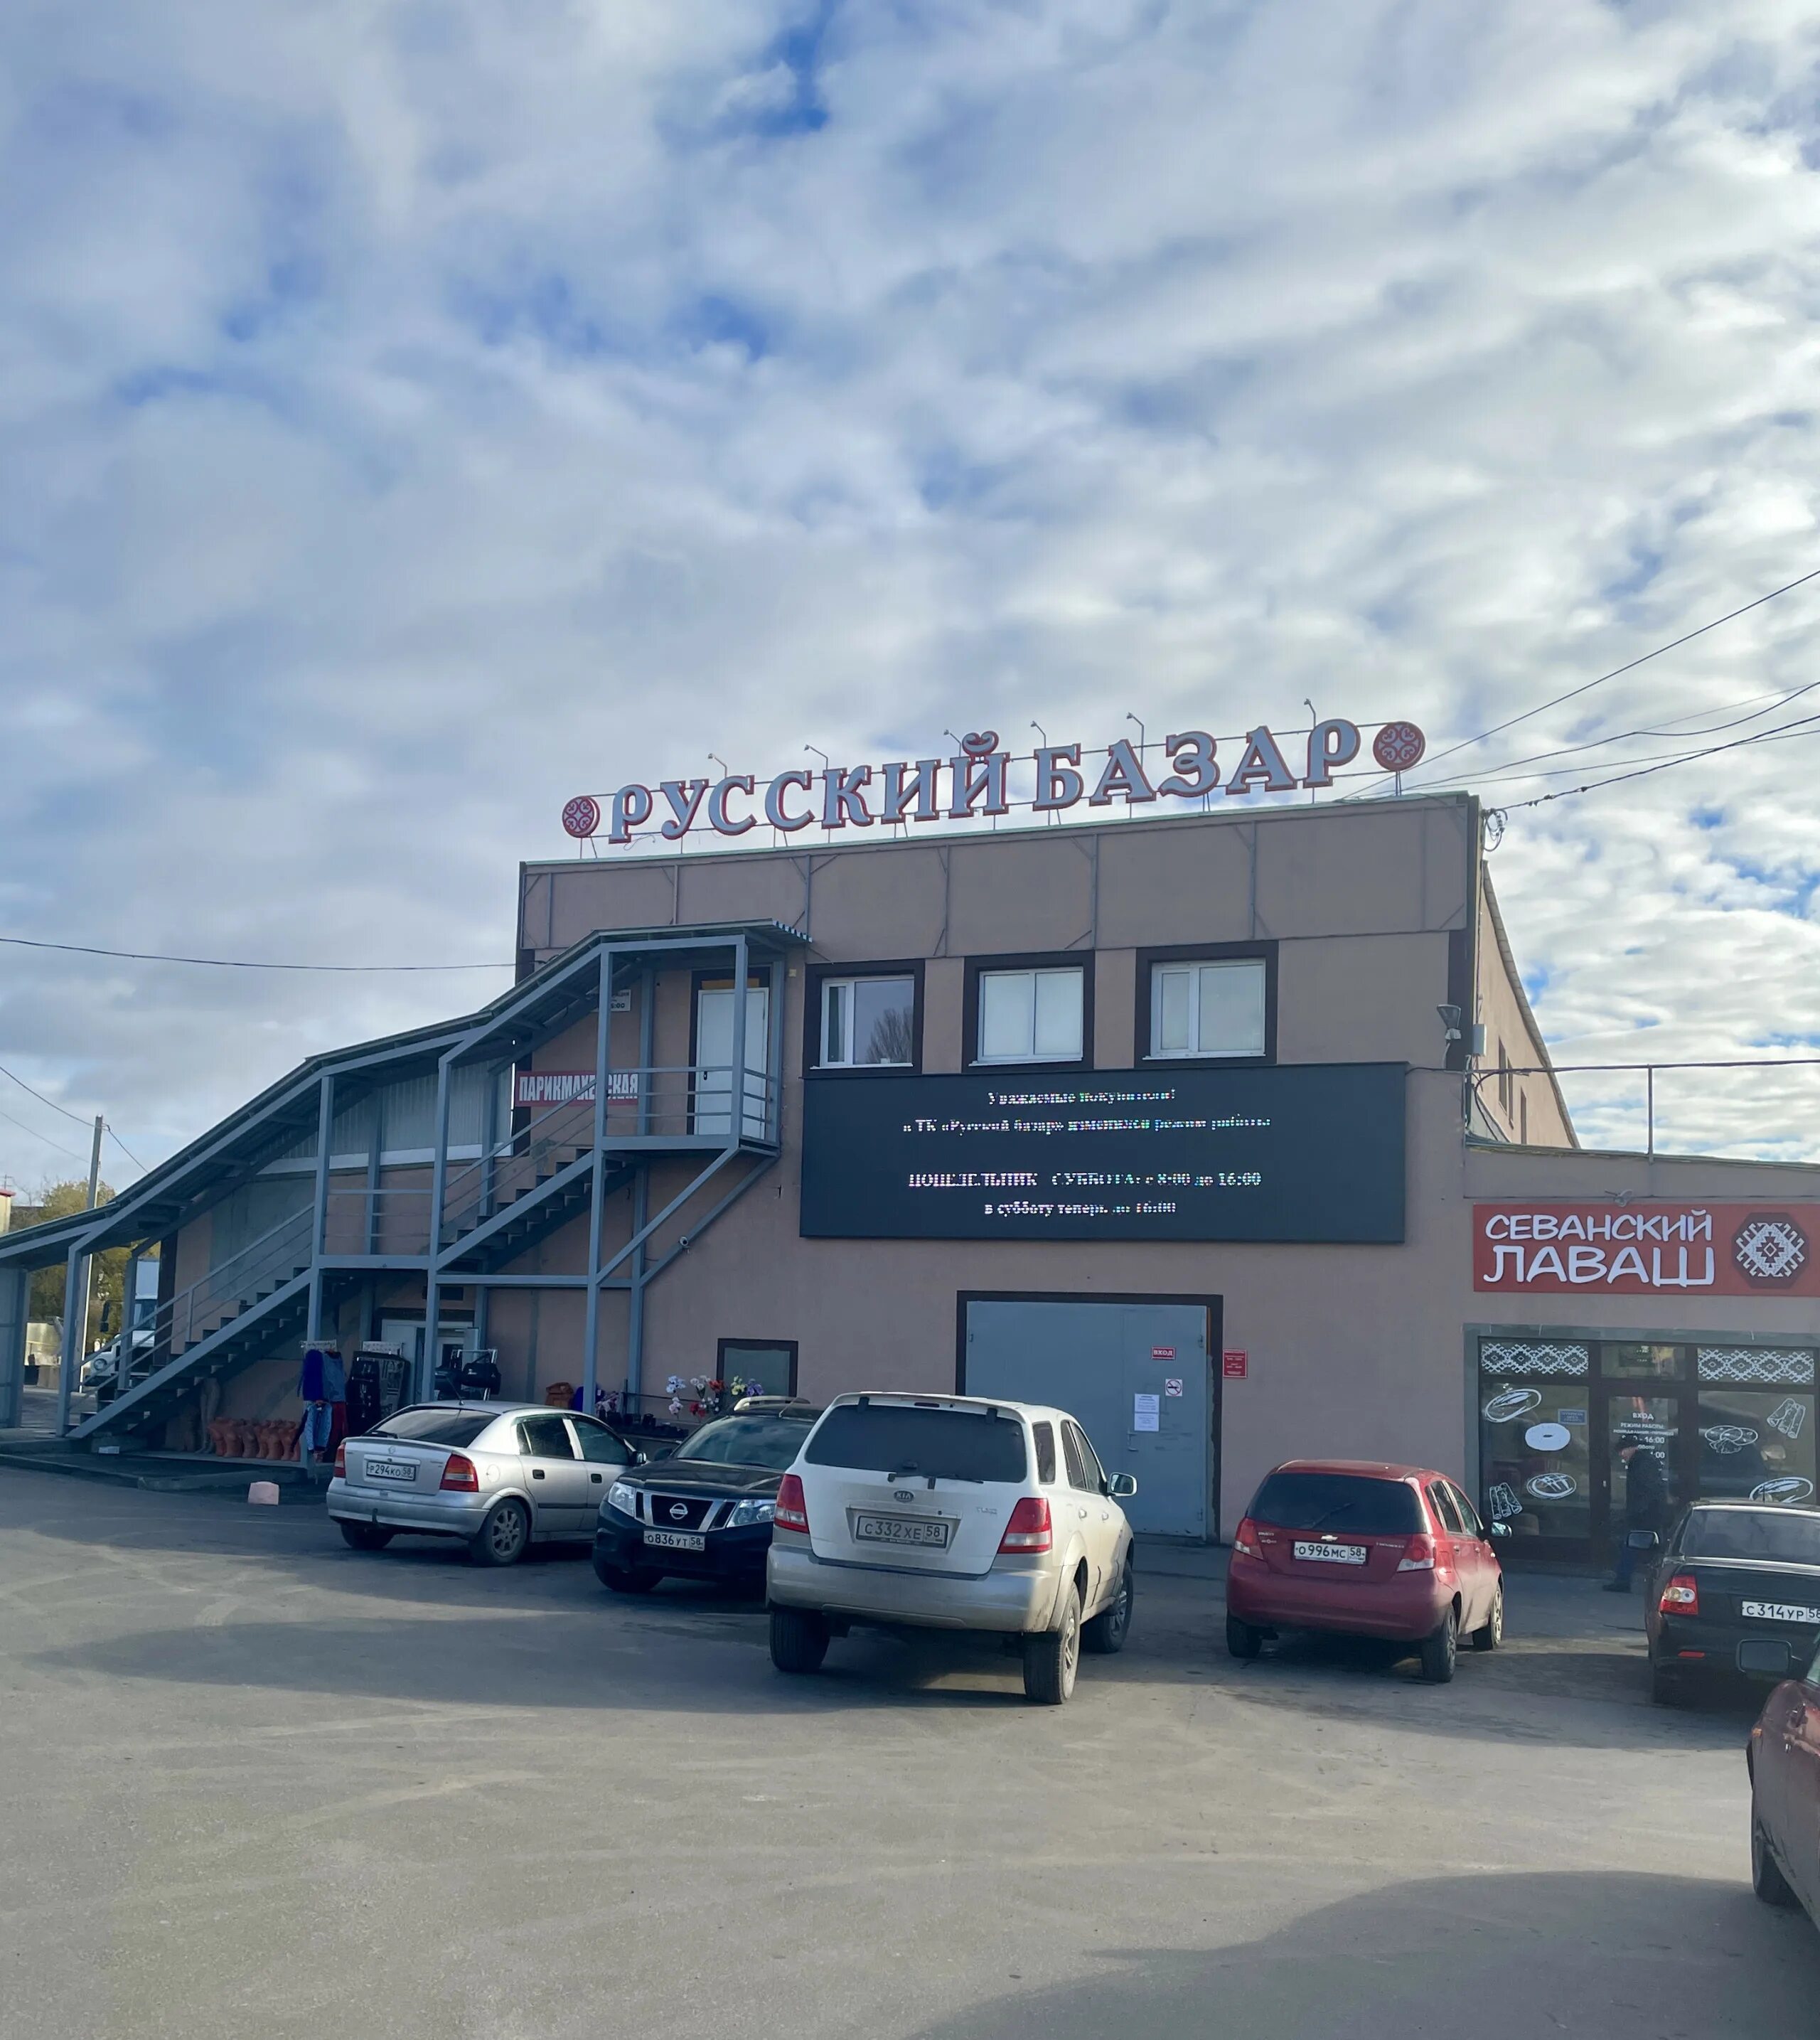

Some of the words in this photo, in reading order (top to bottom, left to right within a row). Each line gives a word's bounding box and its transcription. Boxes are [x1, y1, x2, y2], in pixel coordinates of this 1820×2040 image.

[609, 730, 1010, 844] РУССКИЙ
[1032, 719, 1361, 811] БАЗАР
[519, 1074, 638, 1101] ПАРИКМАХЕСКАЯ
[915, 1119, 937, 1132] ТК
[1219, 1172, 1262, 1186] 16:00
[997, 1200, 1054, 1217] субботу
[1485, 1209, 1713, 1241] СЕВАНСКИЙ
[1483, 1245, 1715, 1288] ЛАВАШ
[1632, 1412, 1654, 1421] ВХОД
